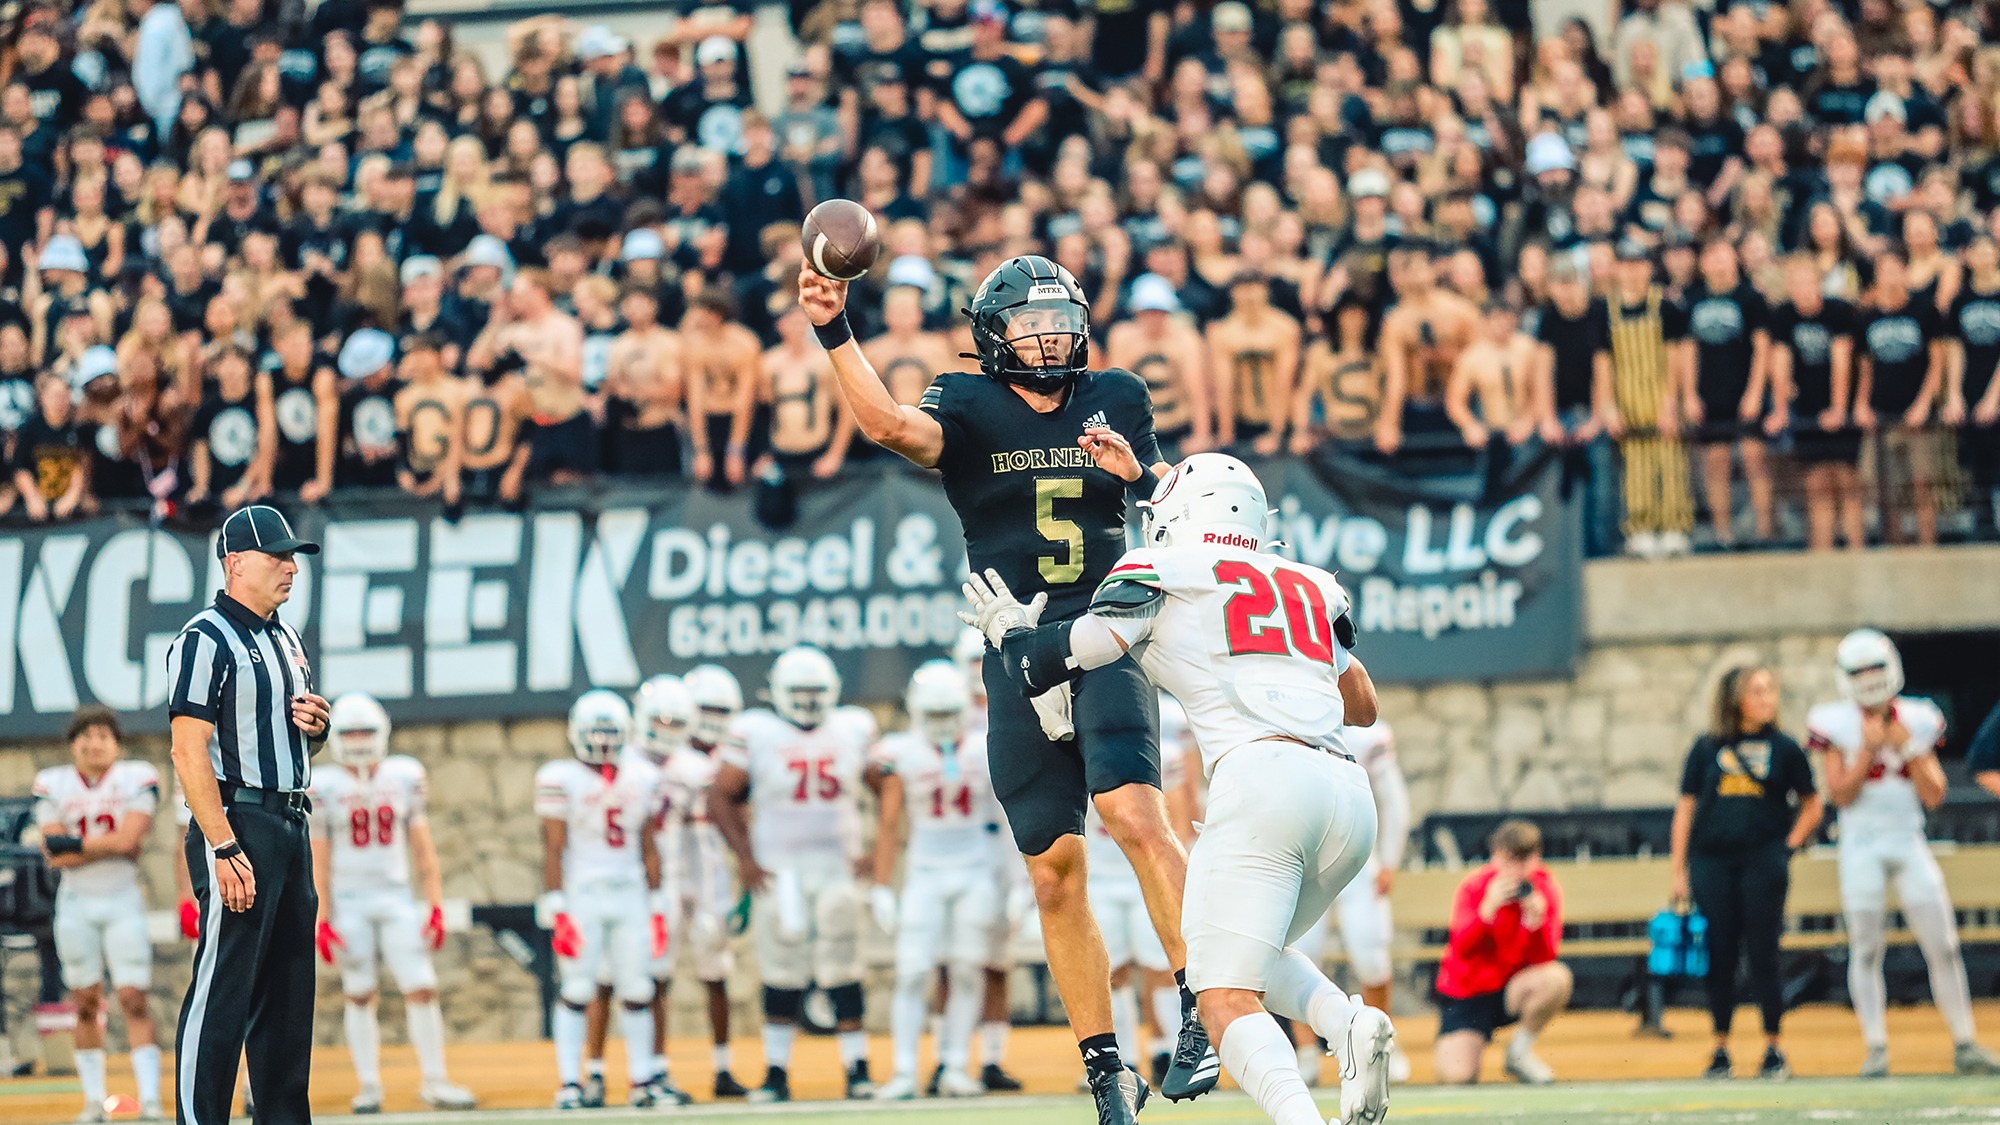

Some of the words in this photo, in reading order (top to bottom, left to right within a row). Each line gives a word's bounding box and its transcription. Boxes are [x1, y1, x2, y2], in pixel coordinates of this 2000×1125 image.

[1037, 287, 1063, 295] MTXE
[1082, 420, 1110, 429] adidas
[991, 447, 1101, 473] HORNET
[648, 516, 876, 601] Diesel
[886, 512, 944, 587] &
[1403, 494, 1544, 574] LLC
[1034, 475, 1085, 584] 5
[1203, 532, 1258, 551] Riddell
[1211, 559, 1335, 668] 20
[1360, 570, 1524, 640] Repair
[249, 648, 262, 663] S
[788, 756, 842, 803] 75
[931, 783, 973, 819] 14
[351, 805, 395, 847] 88
